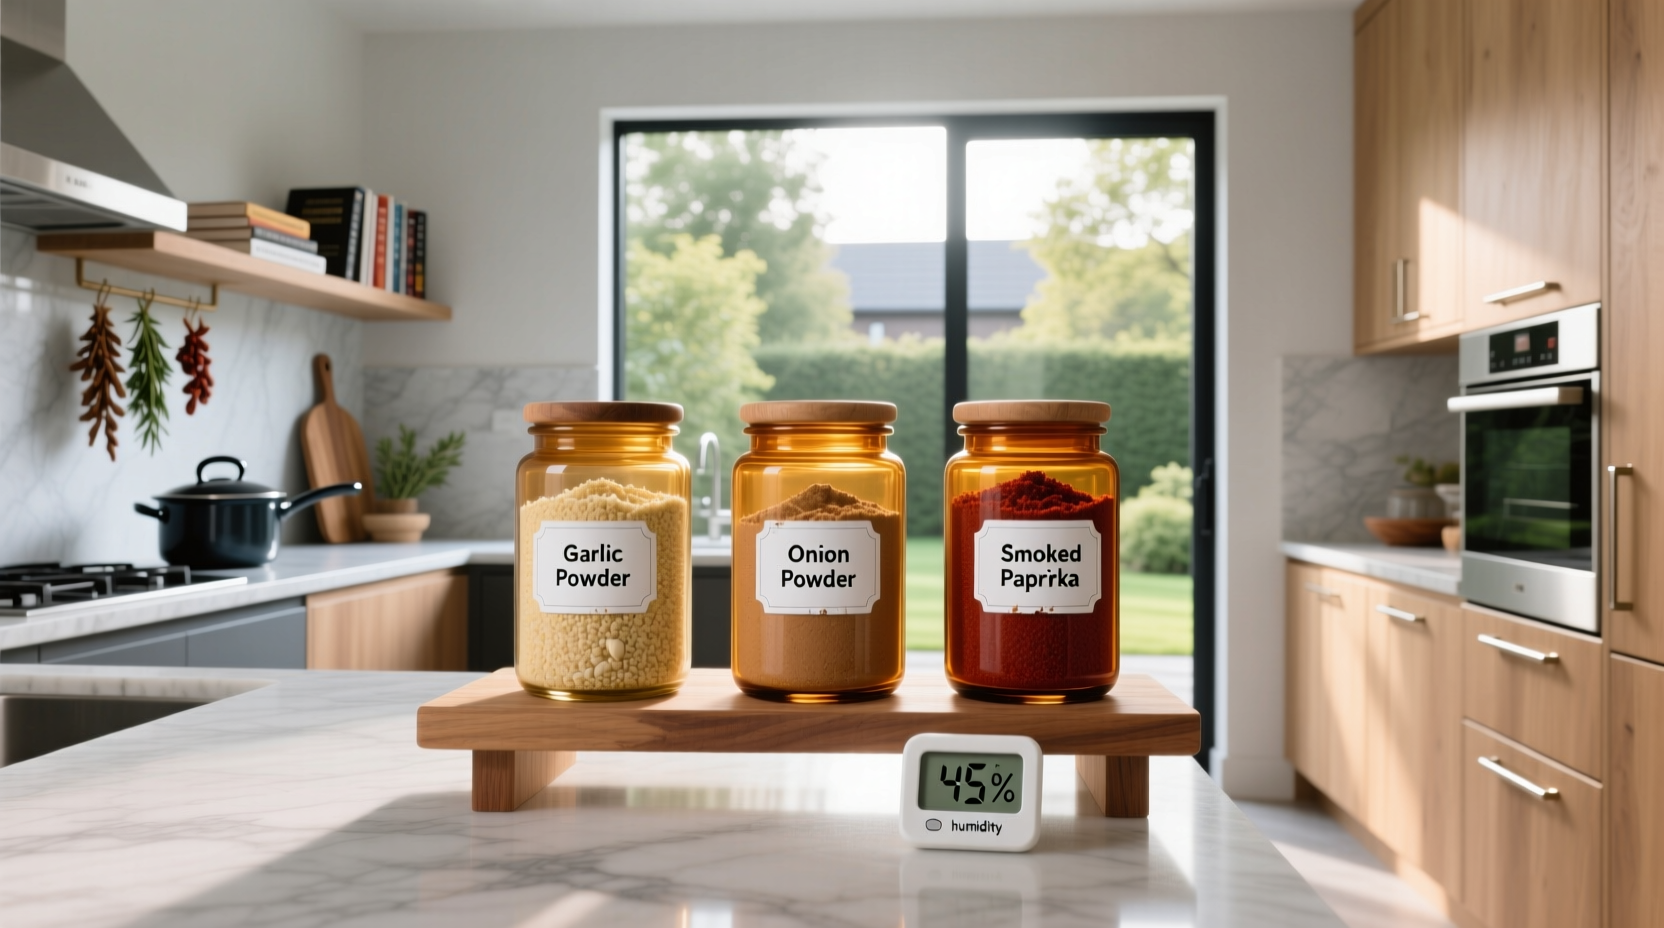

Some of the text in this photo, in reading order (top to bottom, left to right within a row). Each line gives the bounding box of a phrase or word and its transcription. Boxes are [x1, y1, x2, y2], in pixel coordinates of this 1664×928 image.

[563, 543, 624, 563] Garlic
[788, 544, 850, 563] Onion
[1000, 543, 1082, 563] Smoked
[556, 568, 631, 587] Powder
[781, 568, 857, 588] Powder
[951, 819, 1003, 836] humidity
